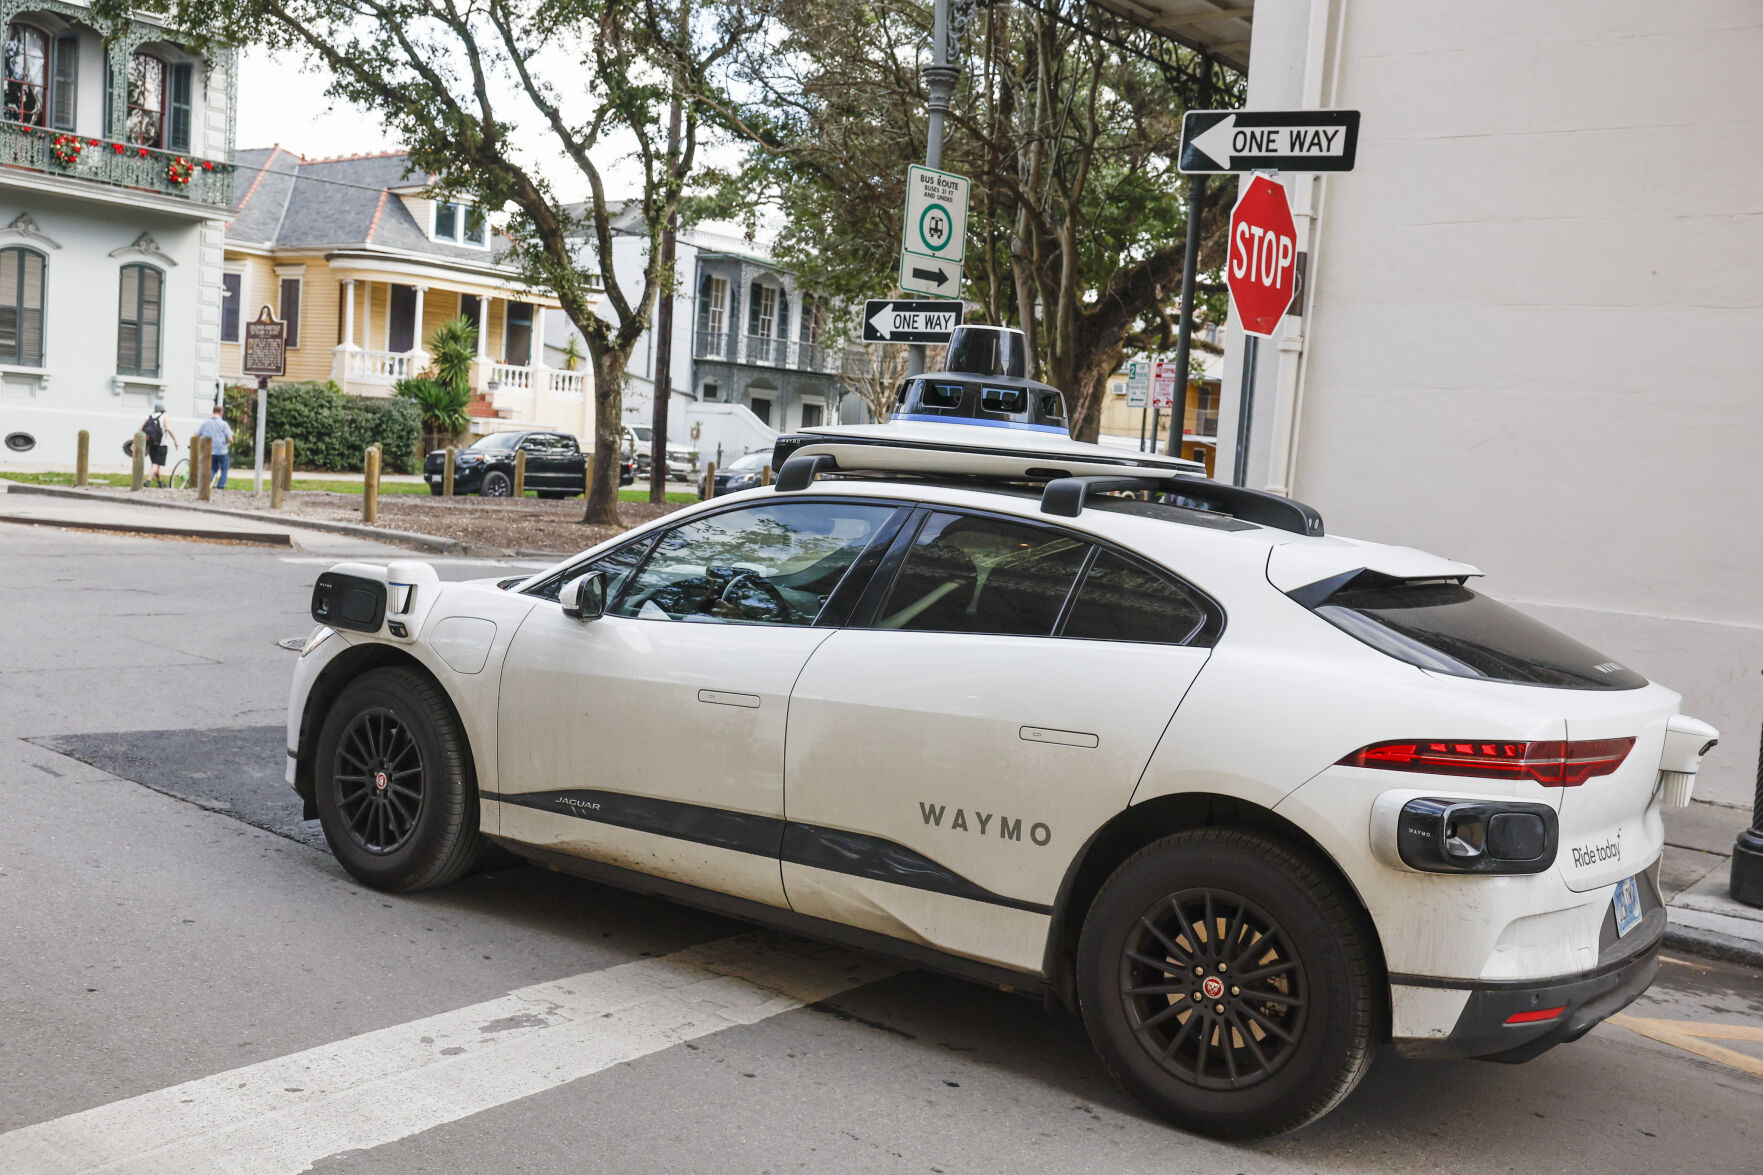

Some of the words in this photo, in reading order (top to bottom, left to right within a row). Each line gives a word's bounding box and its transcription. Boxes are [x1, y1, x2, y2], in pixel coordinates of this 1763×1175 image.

[1232, 130, 1279, 153] ONE
[1289, 129, 1340, 153] WAY
[920, 174, 935, 185] BUS
[937, 178, 959, 191] ROUTE
[924, 185, 940, 193] BUSES
[1232, 221, 1293, 289] STOP
[893, 313, 920, 330] ONE
[924, 314, 952, 330] WAY
[1129, 366, 1135, 378] 2
[555, 797, 601, 811] JAGUAR
[919, 801, 1052, 847] WAYMO
[1408, 827, 1431, 837] WAYMO
[1572, 844, 1597, 868] Ride
[1596, 838, 1621, 862] today
